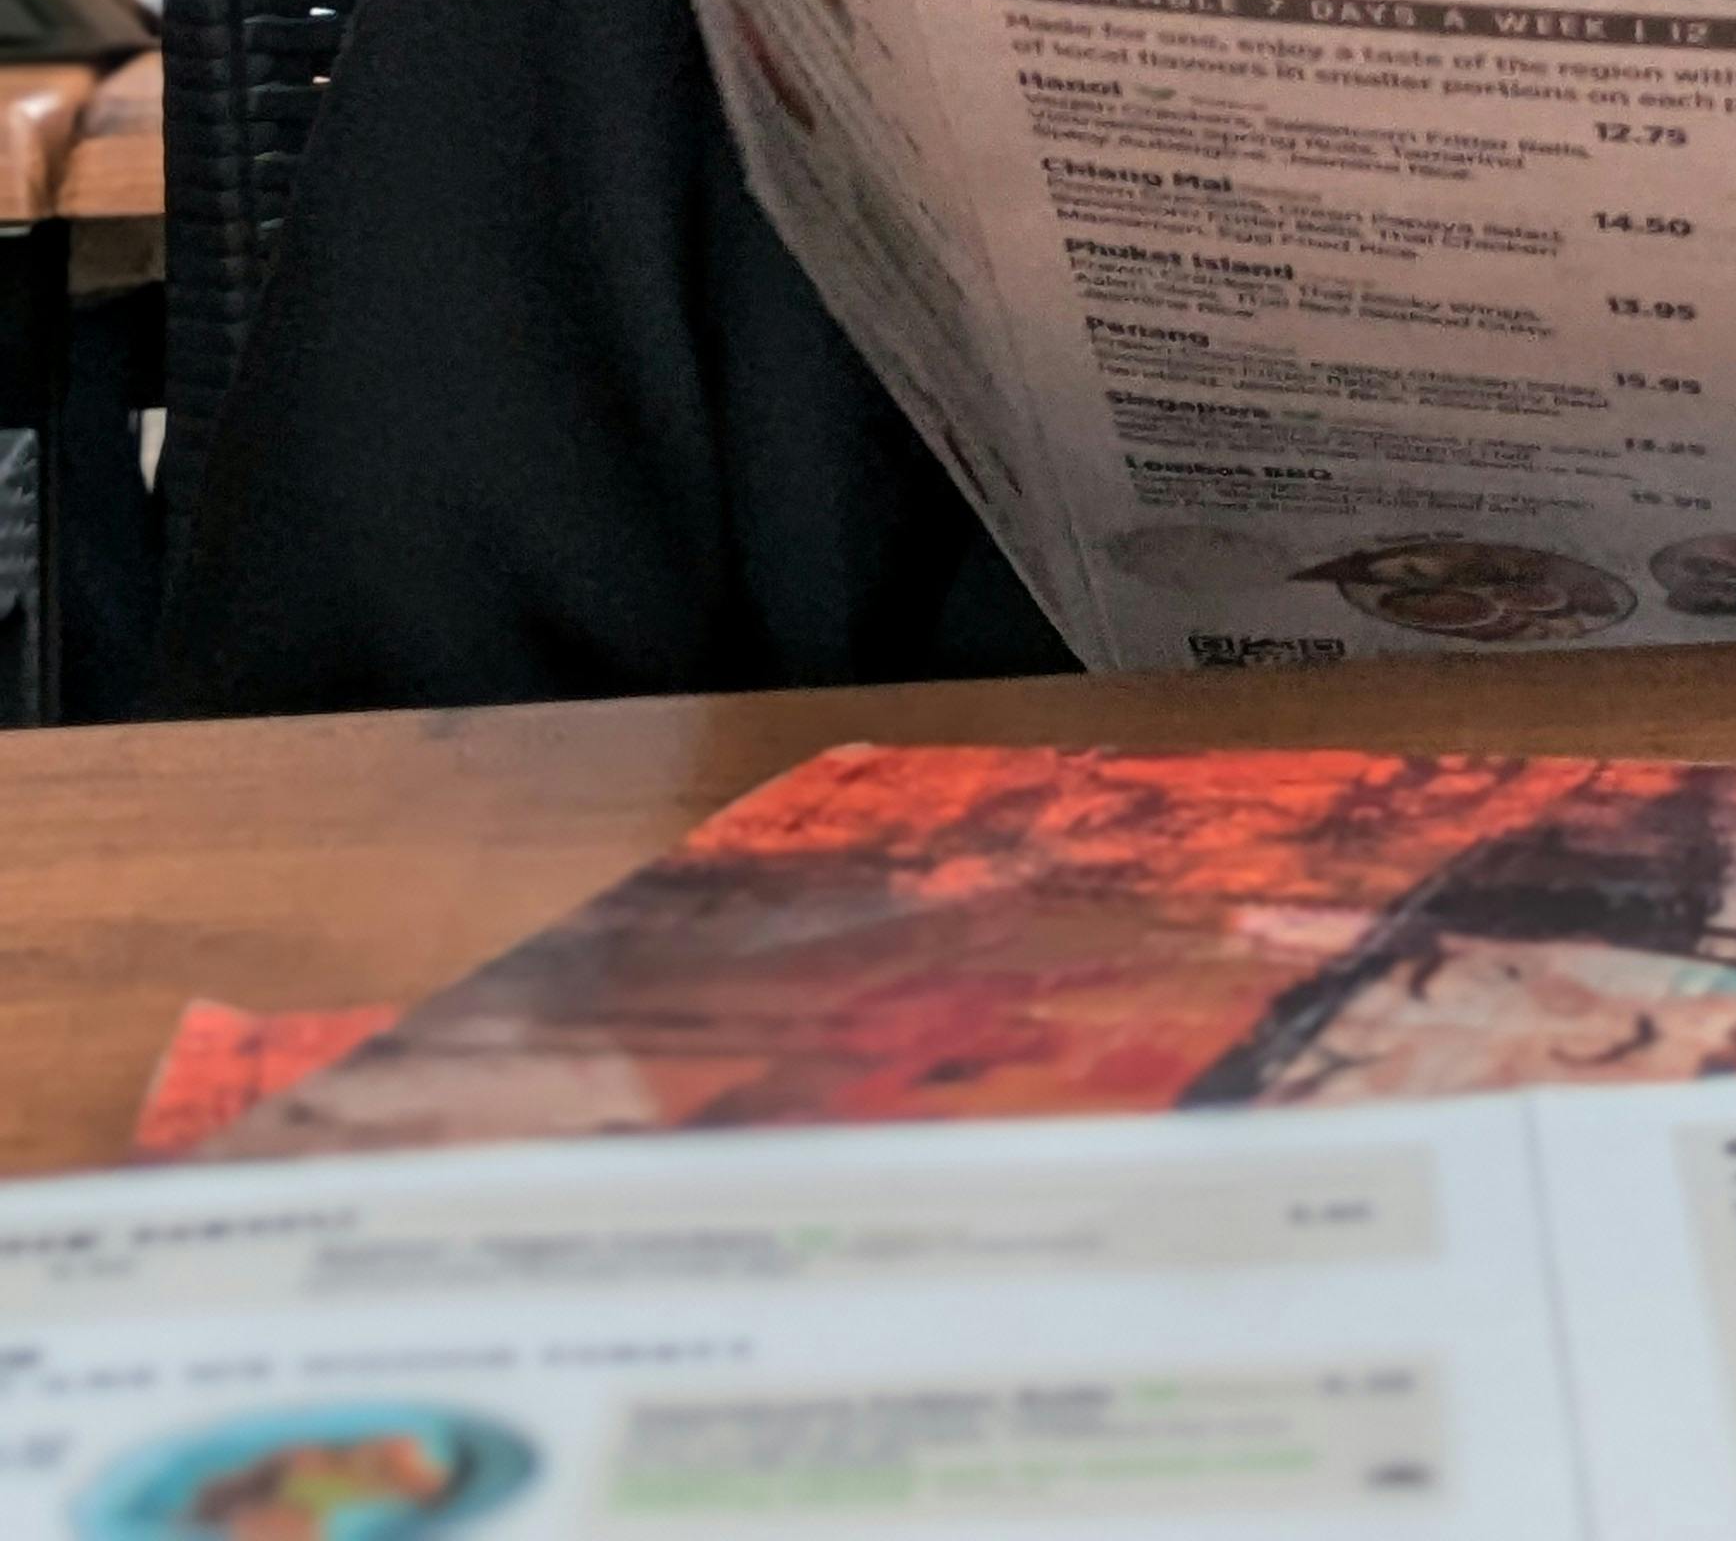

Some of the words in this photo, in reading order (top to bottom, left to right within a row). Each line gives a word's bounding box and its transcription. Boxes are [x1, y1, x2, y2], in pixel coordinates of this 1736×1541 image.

[1442, 6, 1465, 30] A
[1494, 10, 1606, 40] WEEK
[1671, 20, 1709, 45] 12
[1237, 36, 1324, 61] enjoy
[1455, 51, 1489, 71] of
[1496, 53, 1548, 75] the
[1557, 61, 1664, 85] region
[1138, 48, 1269, 77] flavours
[1315, 67, 1430, 91] smaller
[1444, 76, 1577, 103] portions
[1587, 88, 1630, 107] on
[1638, 88, 1714, 113] each
[1594, 120, 1689, 147] 12.75
[1041, 156, 1163, 188] Chiang
[1172, 170, 1232, 192] Mai
[1594, 211, 1695, 237] 14.50
[1064, 236, 1182, 267] Phuket
[1191, 252, 1294, 281] Island
[1085, 314, 1211, 349] Penang
[1262, 466, 1334, 483] BBQ
